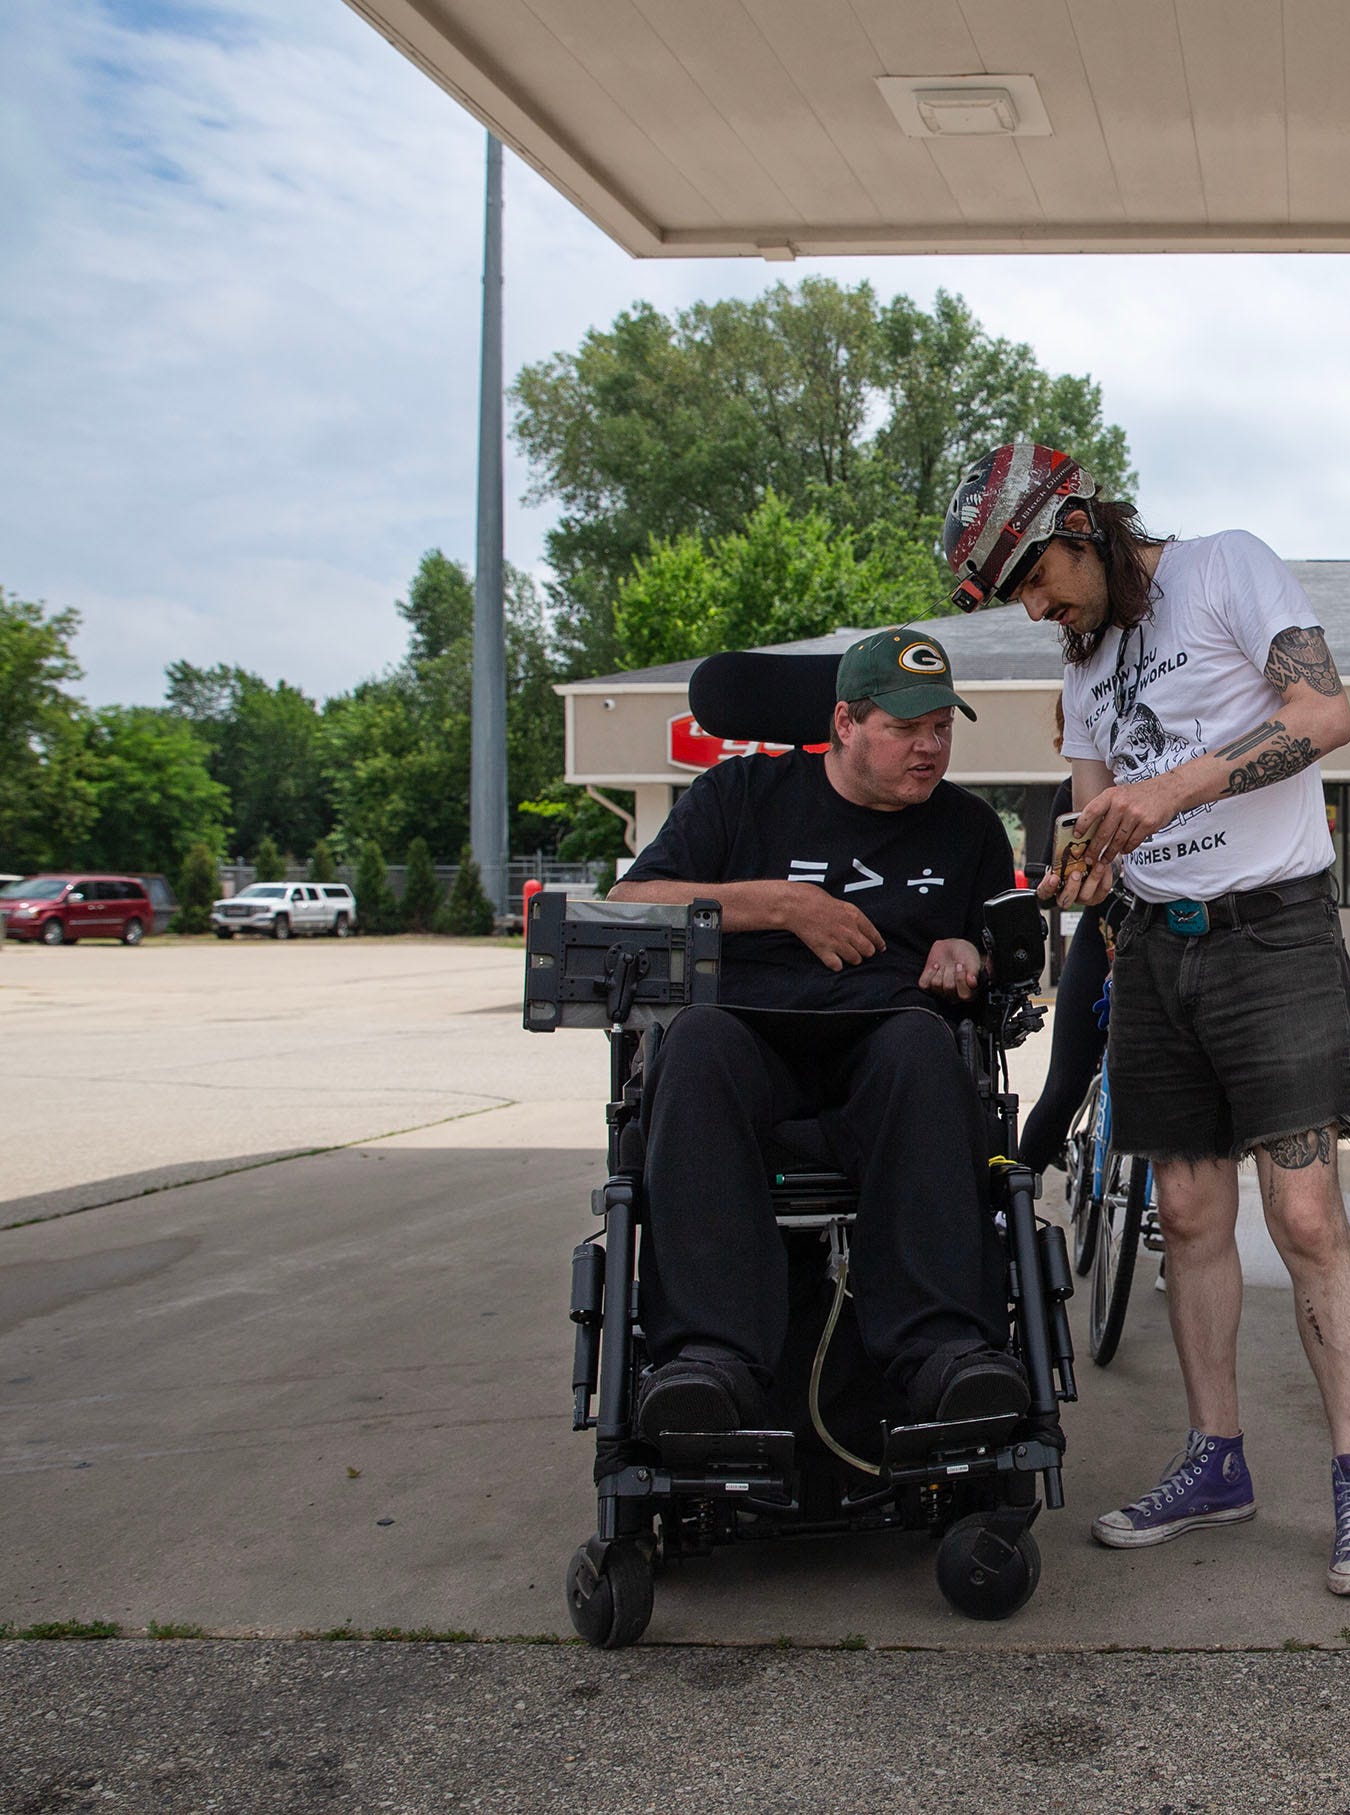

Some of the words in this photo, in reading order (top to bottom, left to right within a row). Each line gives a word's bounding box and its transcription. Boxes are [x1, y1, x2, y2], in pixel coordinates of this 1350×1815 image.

[1021, 491, 1047, 519] Black
[1133, 647, 1157, 672] YOU
[1140, 652, 1188, 692] WORLD
[1130, 846, 1171, 865] PUSHES
[1177, 831, 1226, 857] BACK
